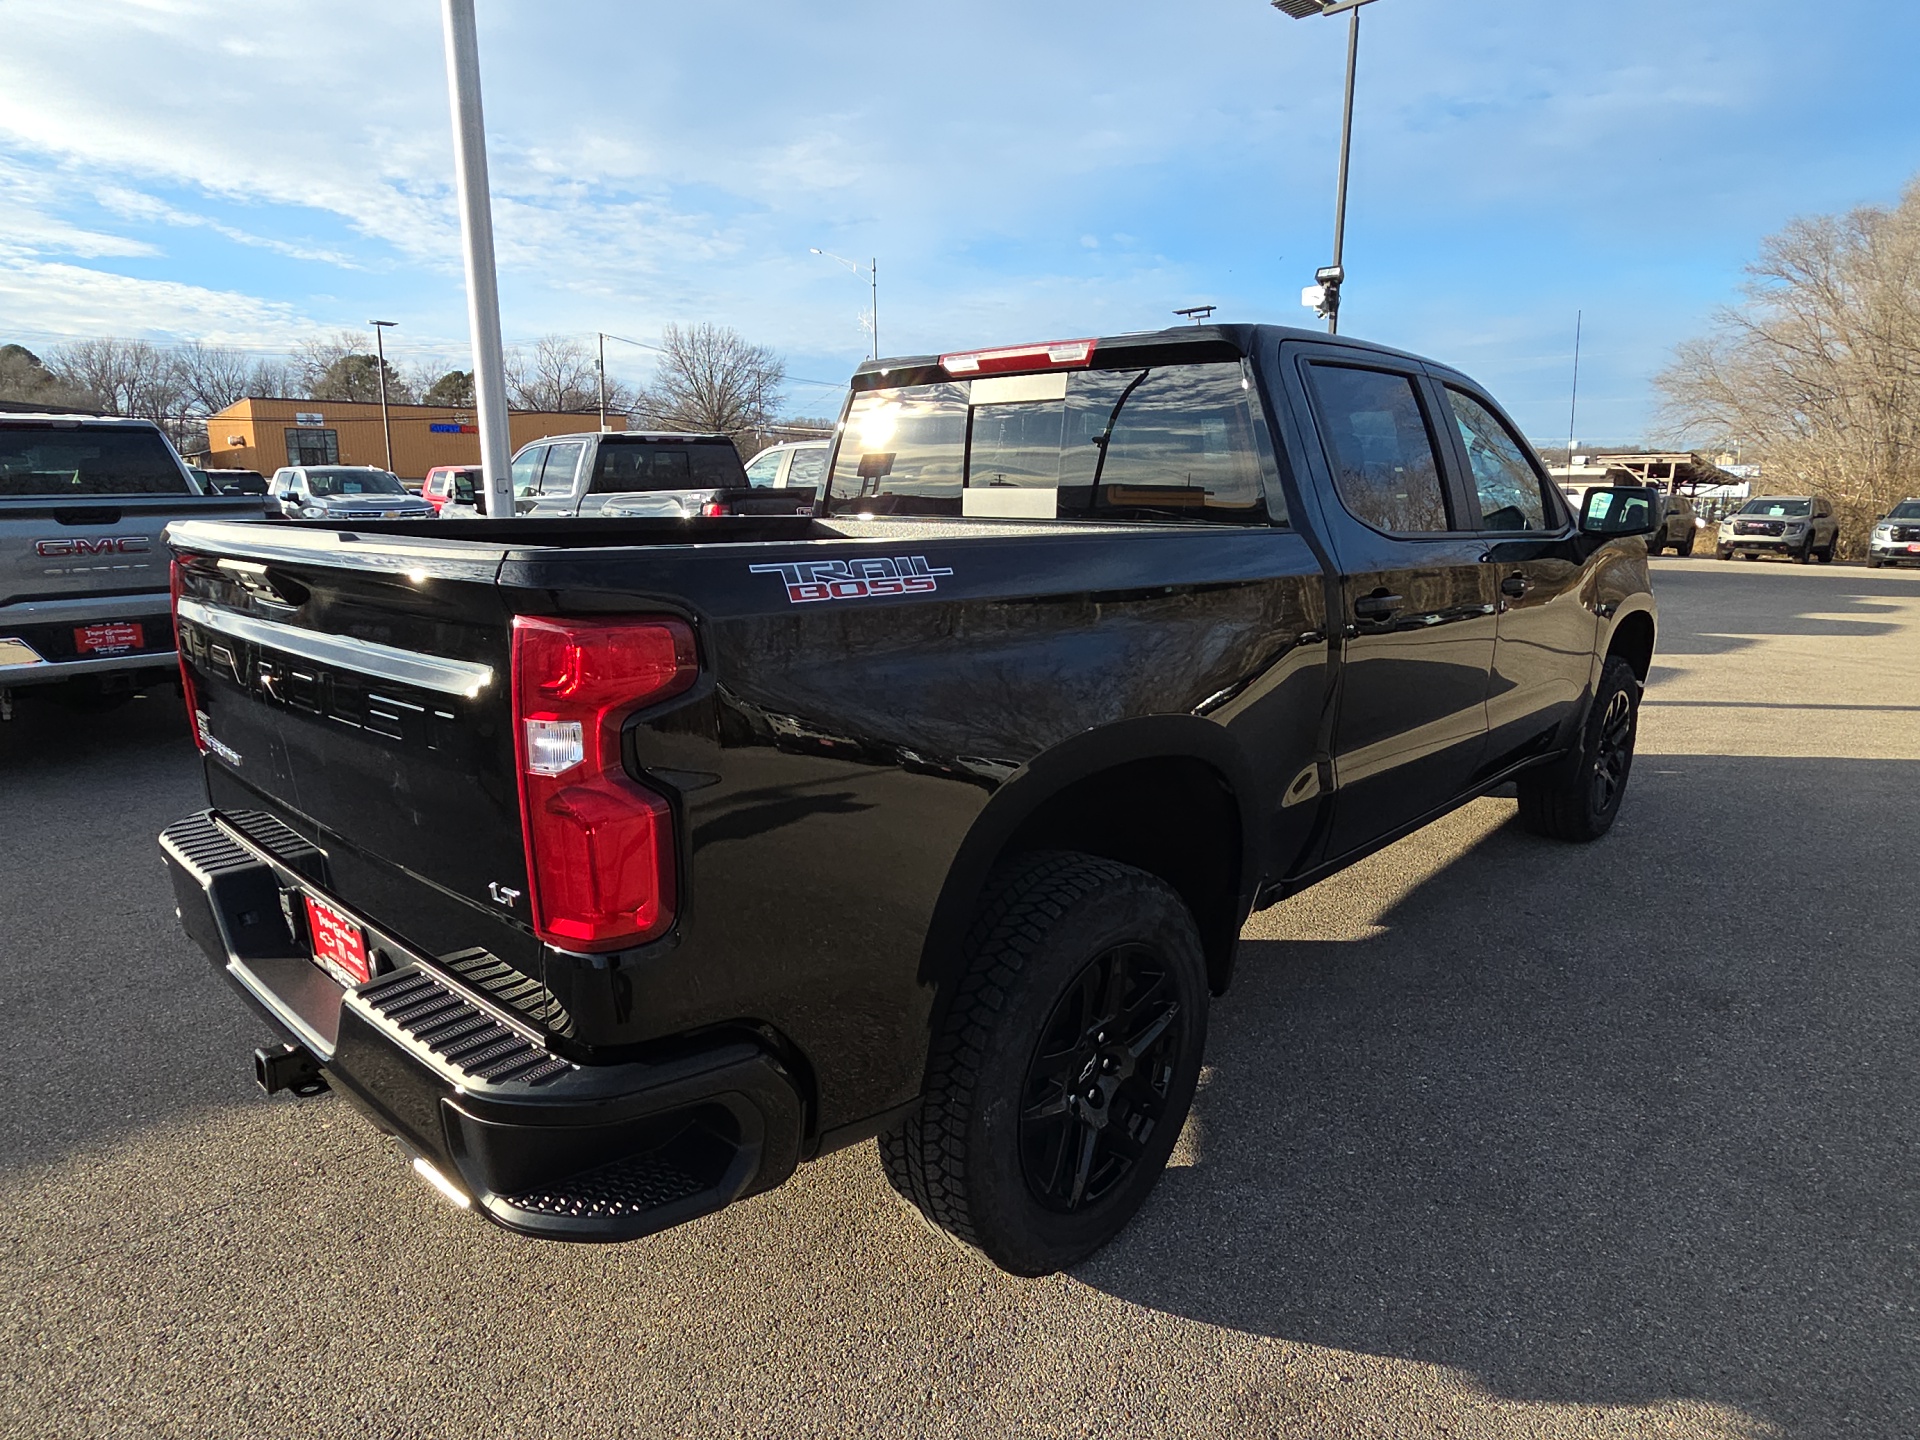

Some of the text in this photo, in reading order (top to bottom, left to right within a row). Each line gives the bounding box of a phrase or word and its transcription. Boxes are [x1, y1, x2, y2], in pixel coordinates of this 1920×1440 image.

[35, 536, 151, 557] GMC
[749, 556, 953, 585] TRAIL
[787, 574, 937, 603] BOSS
[178, 622, 456, 750] CHEVROLET
[488, 881, 520, 907] LT
